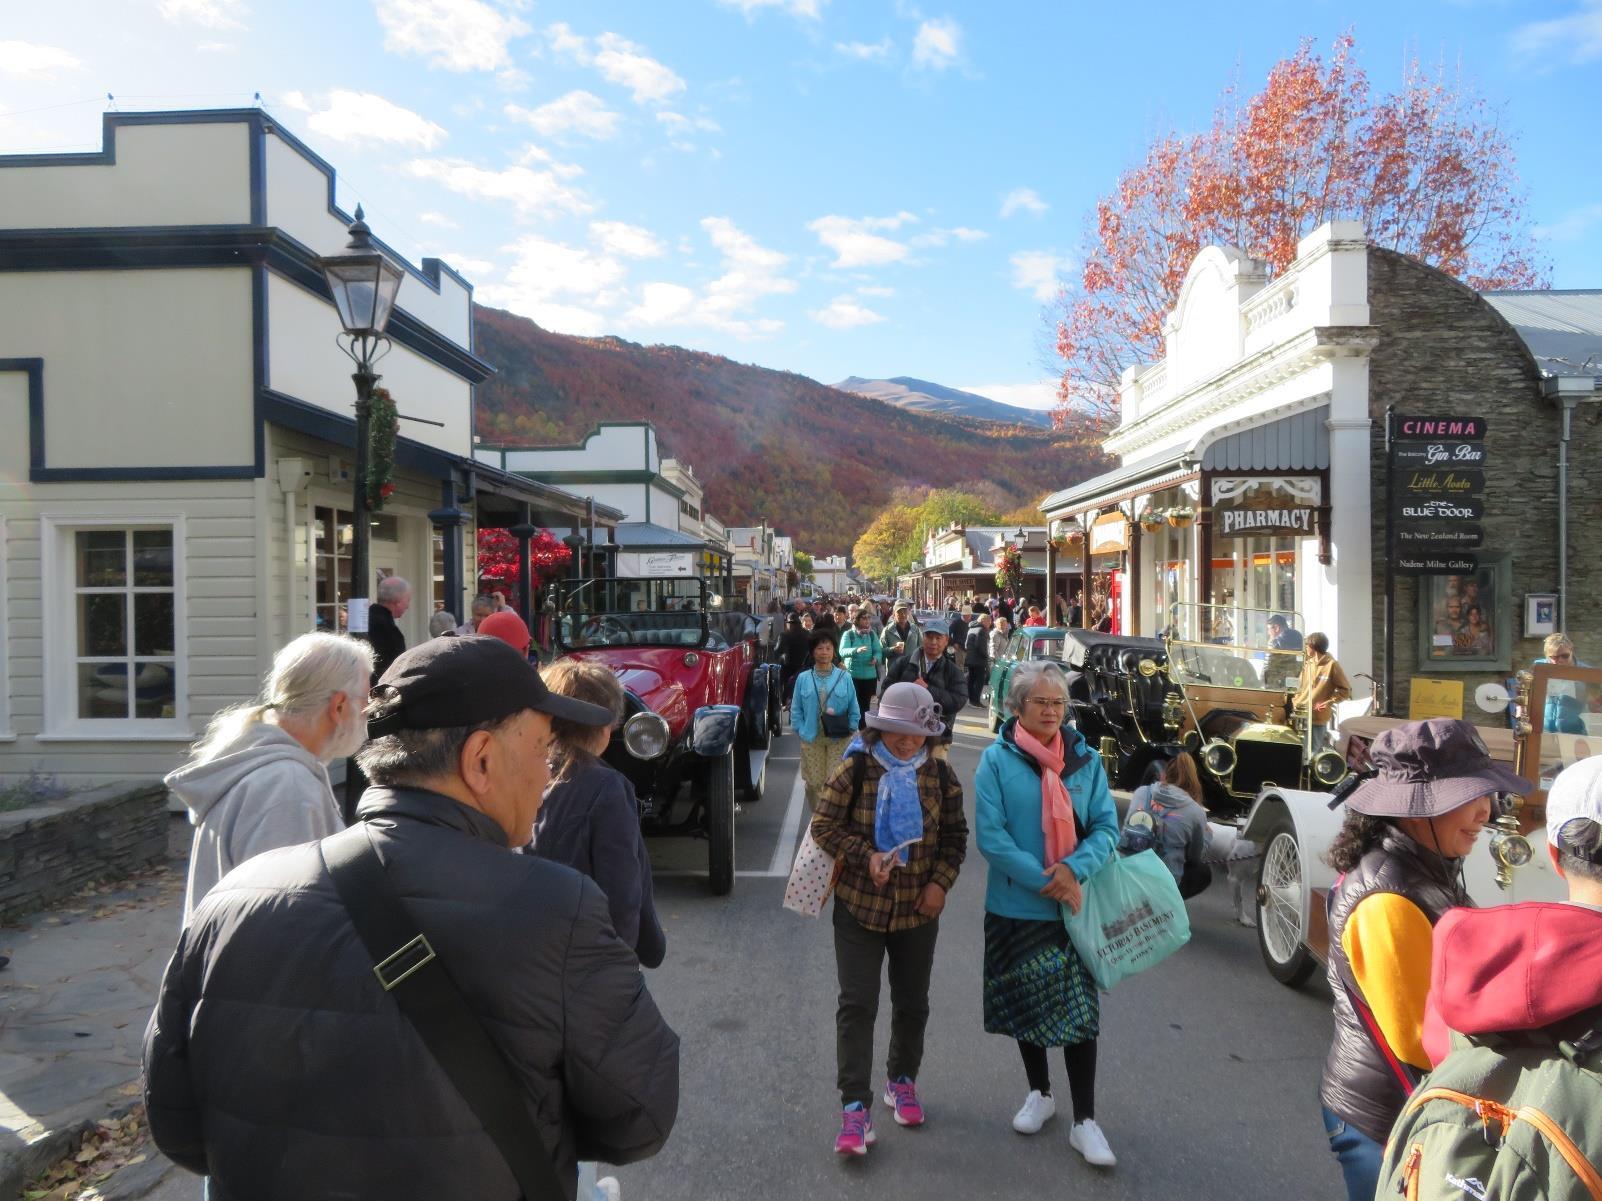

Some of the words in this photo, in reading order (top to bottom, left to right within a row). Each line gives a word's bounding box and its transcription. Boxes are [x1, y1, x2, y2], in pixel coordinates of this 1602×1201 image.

[1403, 421, 1476, 435] CINEMA
[1425, 445, 1449, 465] Gin
[1453, 444, 1482, 460] Bar
[1408, 472, 1439, 488] Little
[1402, 507, 1436, 517] BLUE
[1437, 508, 1474, 518] DOOR
[1224, 509, 1310, 533] PHARMACY
[1400, 532, 1413, 540] The
[1415, 532, 1430, 540] New
[1431, 532, 1458, 540] Zealand
[1459, 532, 1479, 540] Room
[1400, 560, 1425, 568] Nadene
[1426, 560, 1447, 568] Milne
[1448, 560, 1474, 571] Gallery
[1133, 911, 1175, 937] BASEMENT
